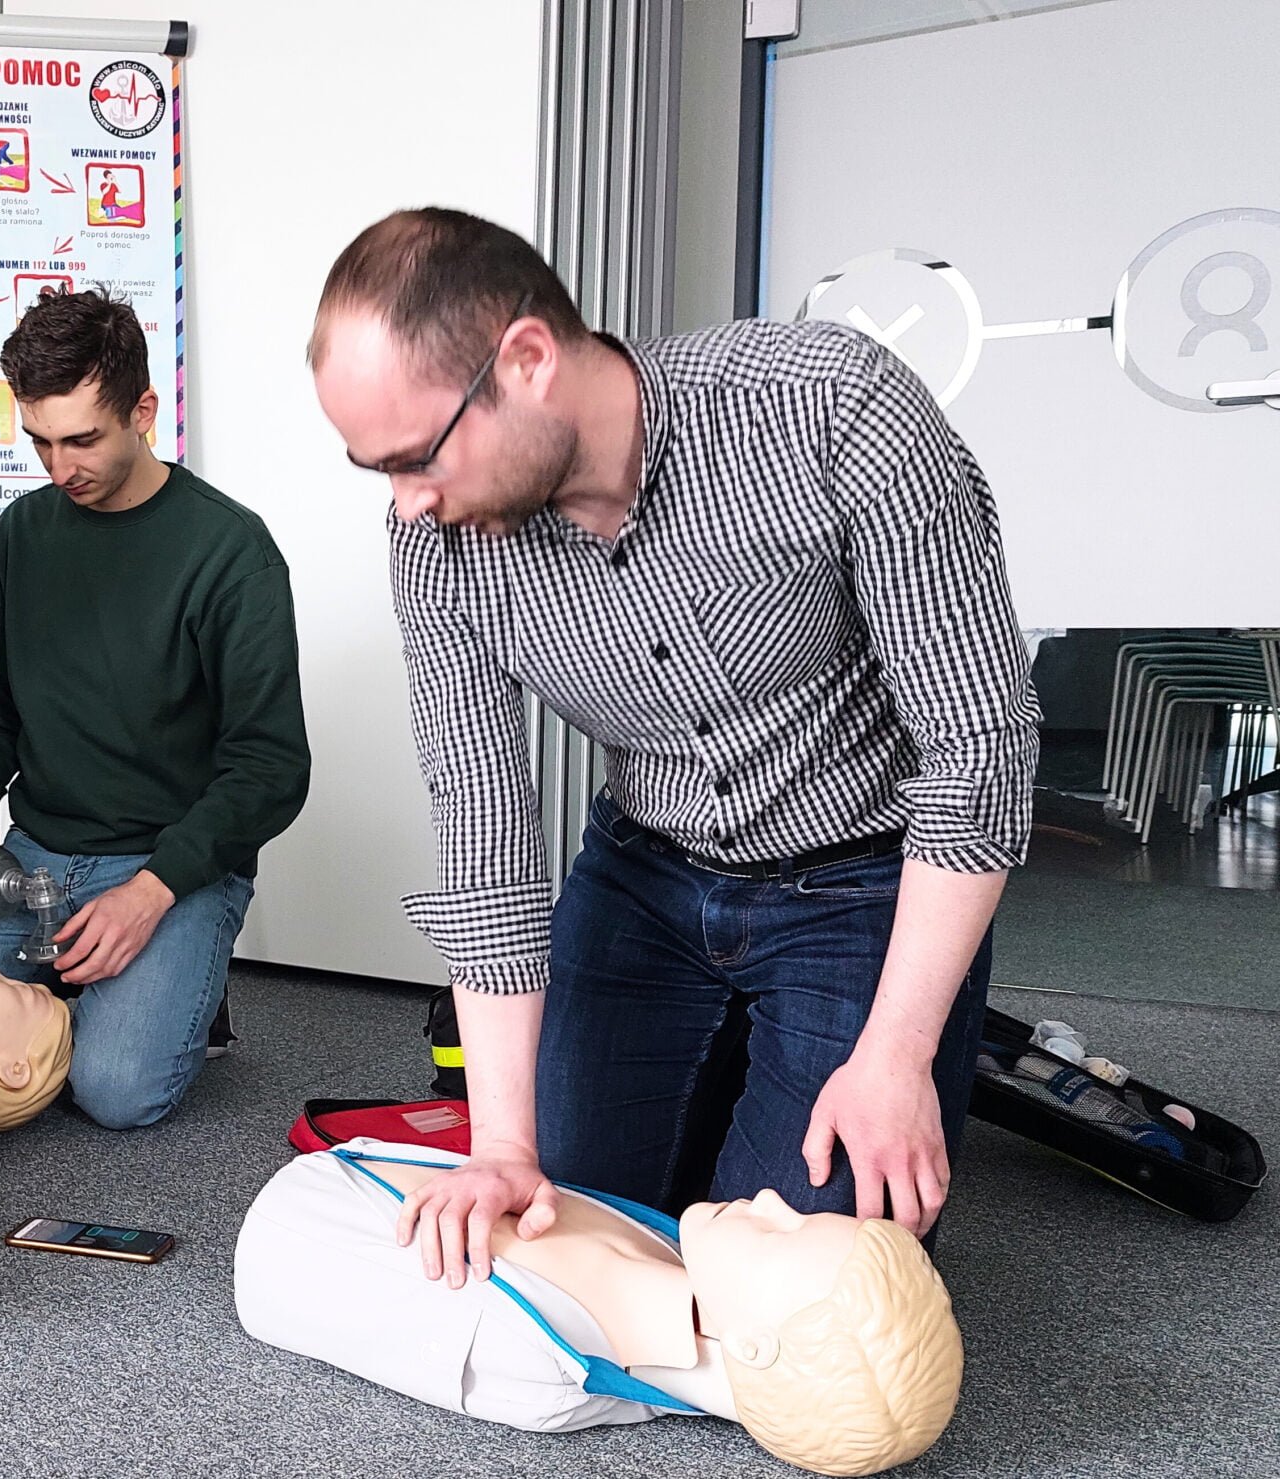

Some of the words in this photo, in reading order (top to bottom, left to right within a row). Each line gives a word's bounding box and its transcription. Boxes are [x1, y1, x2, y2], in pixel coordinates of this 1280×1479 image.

[93, 61, 161, 90] www.salcom.info
[71, 148, 118, 159] WEZWANIE
[120, 150, 157, 160] POMOCY
[80, 230, 108, 239] Poproś
[0, 260, 30, 269] NUMER
[33, 260, 47, 270] 112
[49, 261, 66, 270] LUB
[68, 261, 86, 271] 999
